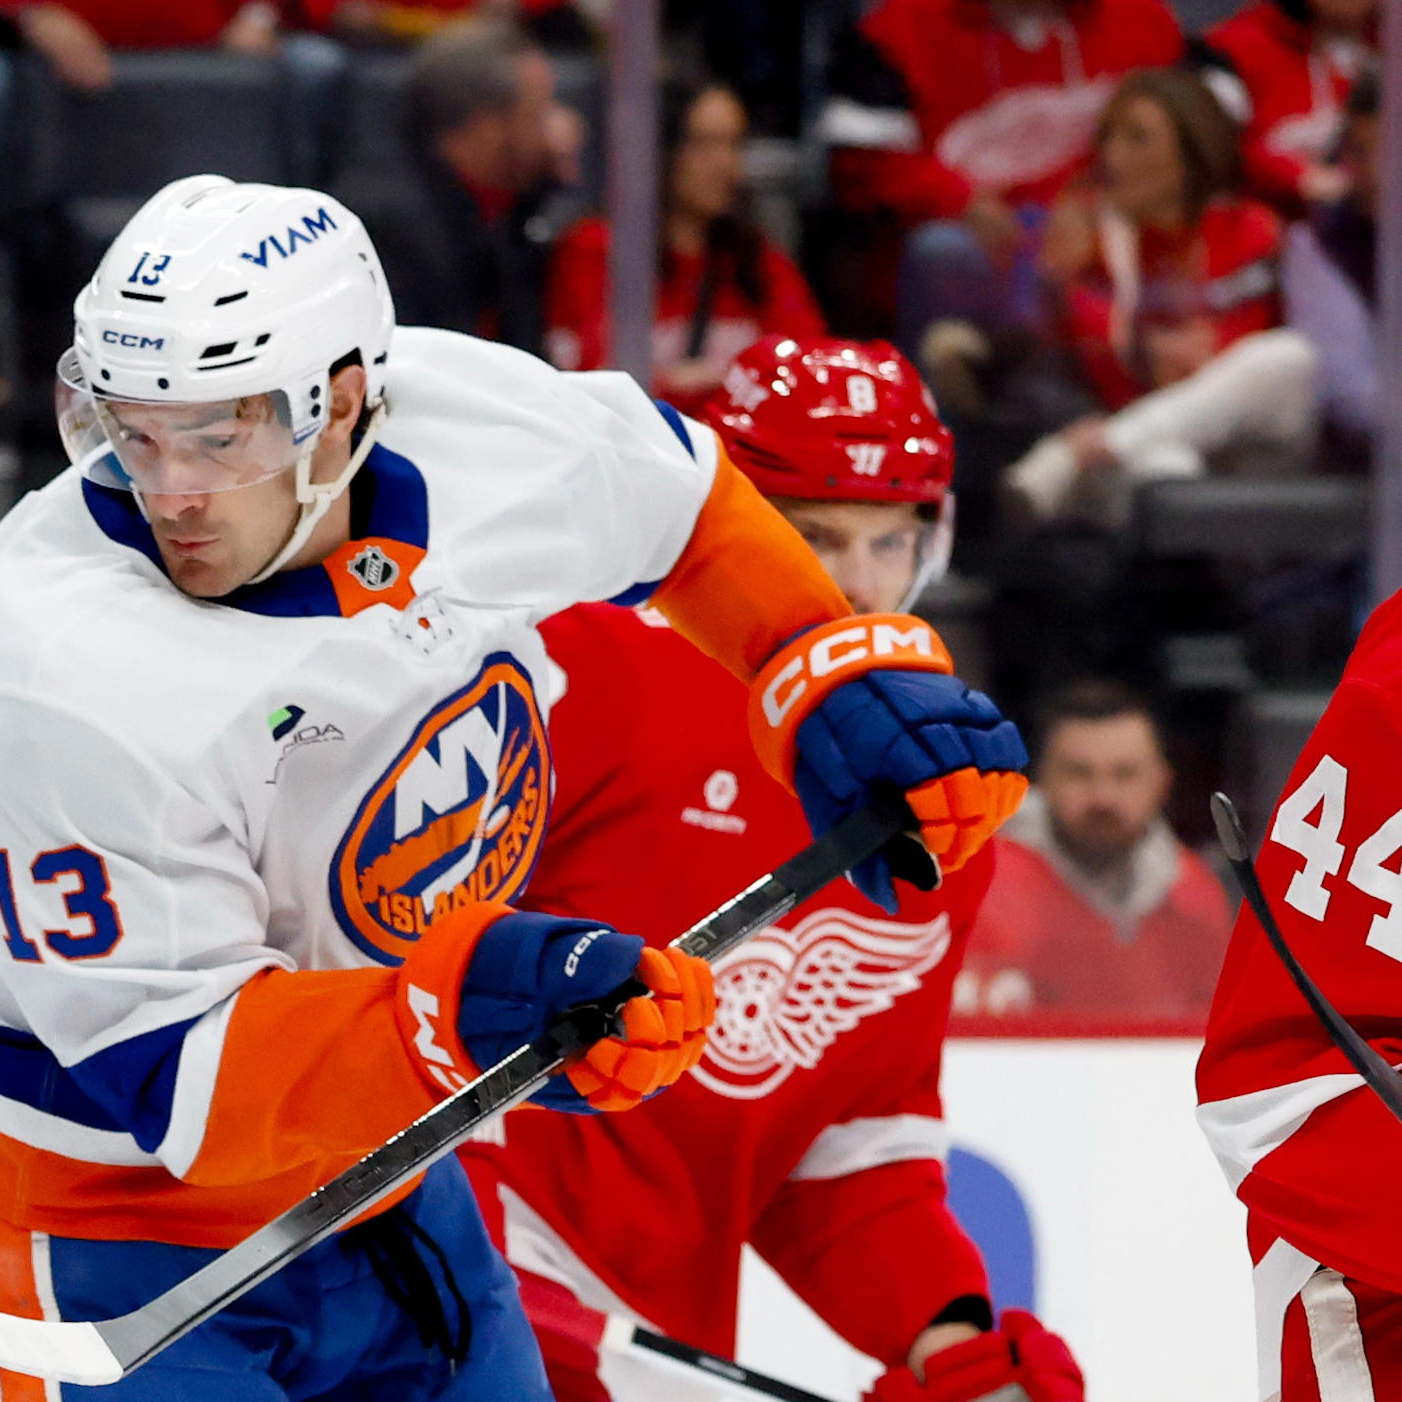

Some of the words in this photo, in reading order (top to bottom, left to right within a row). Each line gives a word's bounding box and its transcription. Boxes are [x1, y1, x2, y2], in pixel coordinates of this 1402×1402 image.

[127, 251, 171, 286] 13
[239, 207, 339, 268] VIAM
[101, 329, 164, 352] CCM
[761, 624, 933, 729] CCM
[378, 766, 539, 934] ISLANDERS
[1269, 753, 1402, 963] 44
